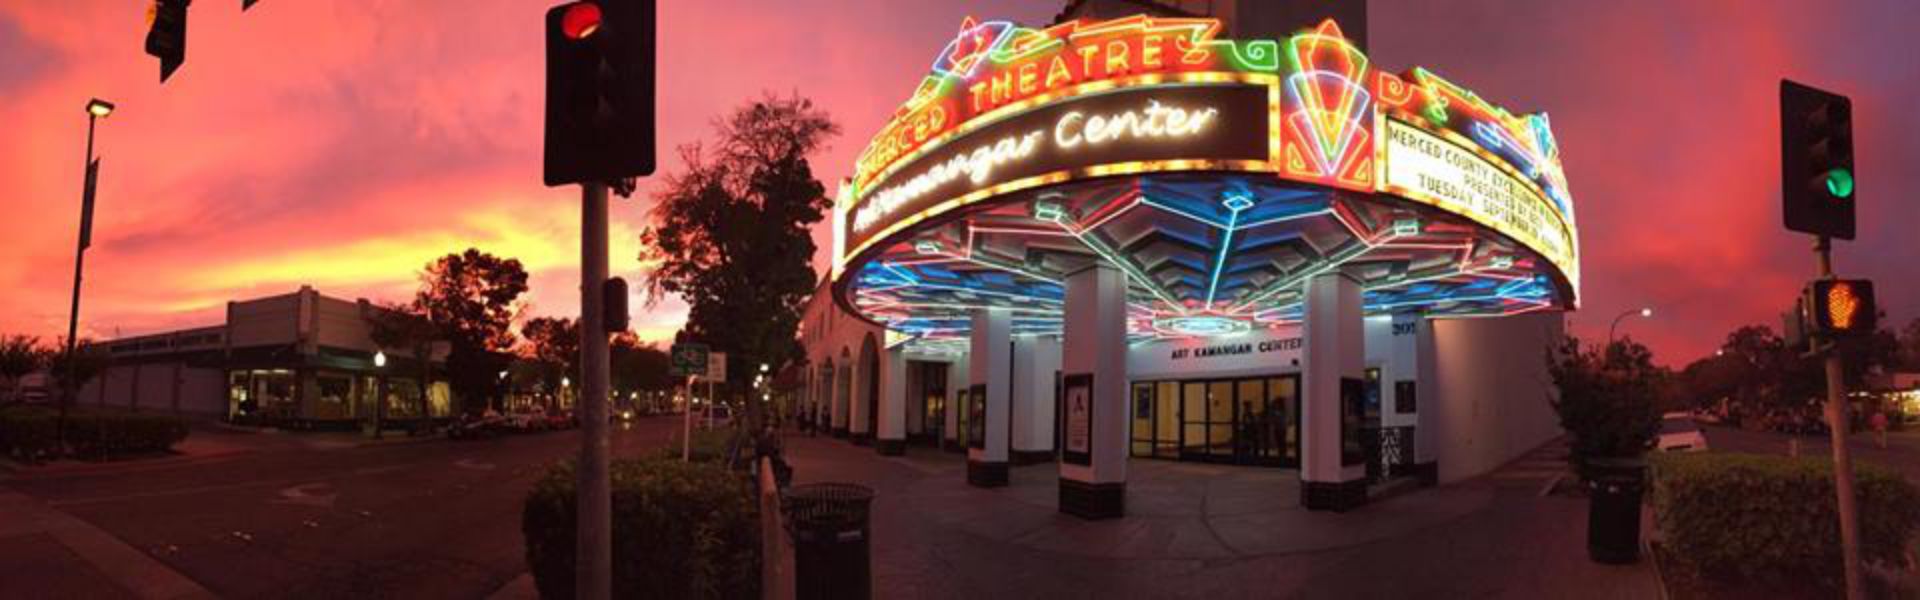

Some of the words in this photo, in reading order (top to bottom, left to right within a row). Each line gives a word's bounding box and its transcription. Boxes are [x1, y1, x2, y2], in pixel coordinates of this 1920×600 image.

[969, 36, 1163, 112] THEATRE
[1055, 98, 1217, 149] Center
[1388, 126, 1441, 159] MERCED
[1445, 149, 1489, 180] COUNTY
[1418, 173, 1473, 206] TUESDAY
[1171, 348, 1189, 359] ART
